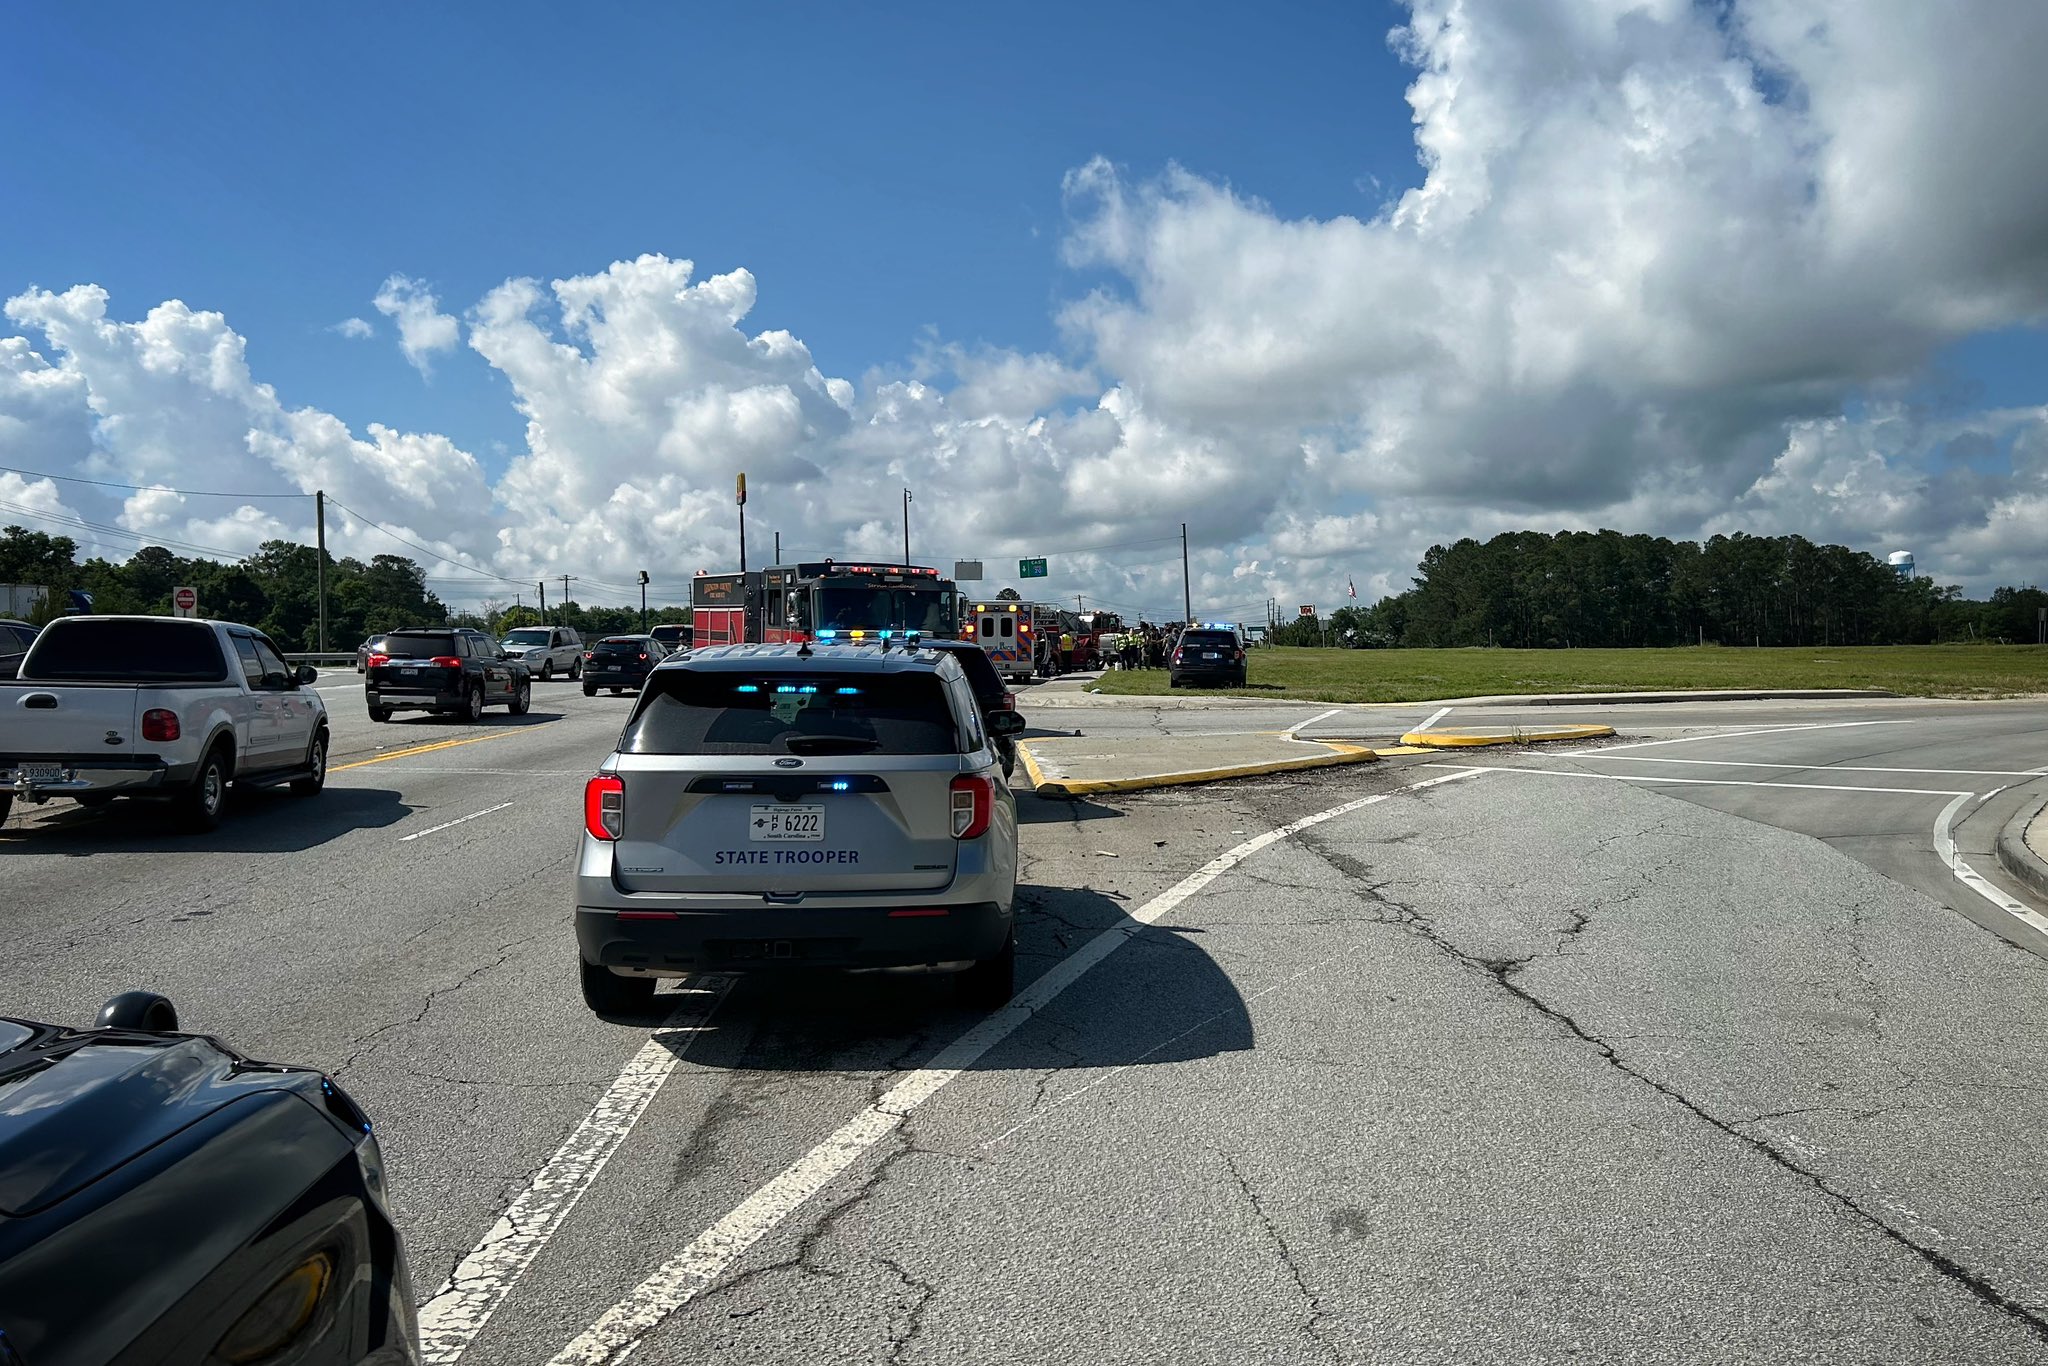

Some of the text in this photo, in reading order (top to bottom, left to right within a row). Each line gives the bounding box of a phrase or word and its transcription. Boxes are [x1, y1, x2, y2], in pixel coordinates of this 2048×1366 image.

[29, 768, 60, 778] 930900
[785, 814, 818, 831] 6222
[715, 850, 860, 864] STATE TROOPER
